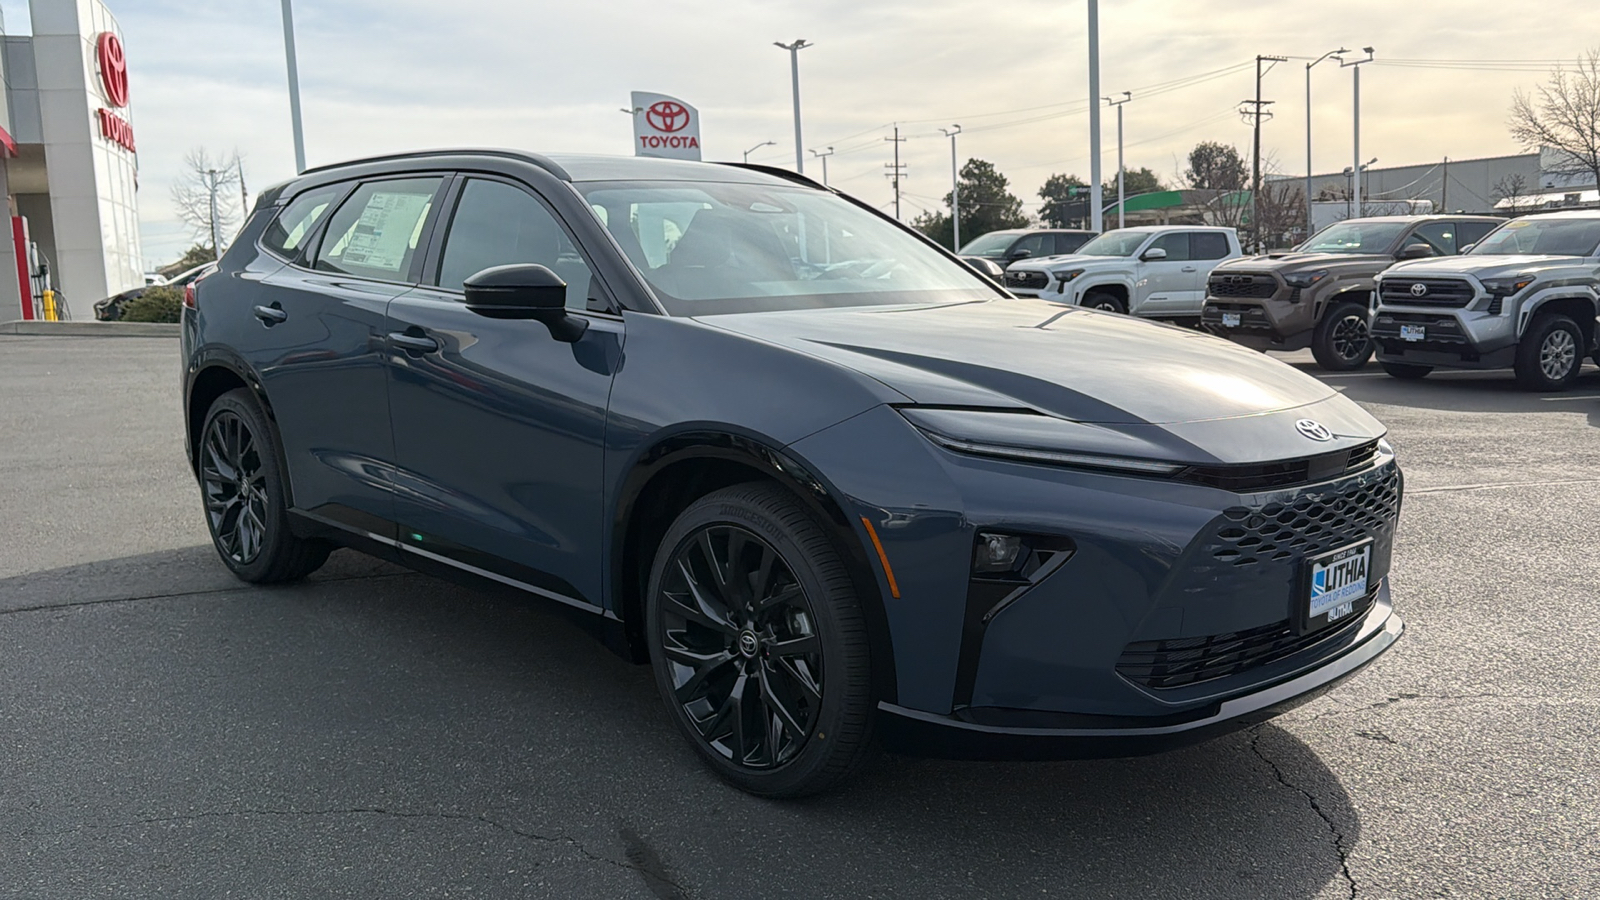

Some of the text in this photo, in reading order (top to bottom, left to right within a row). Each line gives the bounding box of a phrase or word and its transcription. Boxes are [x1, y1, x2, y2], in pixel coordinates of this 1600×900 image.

[98, 108, 135, 153] TOYOT
[640, 136, 699, 148] TOYOTA
[719, 504, 786, 544] BRIDGESTONE
[1332, 550, 1347, 562] SINCE
[1325, 556, 1365, 592] LITHIA
[1311, 580, 1366, 609] TOYOTA OF REDDING
[1333, 601, 1353, 620] LITHIA
